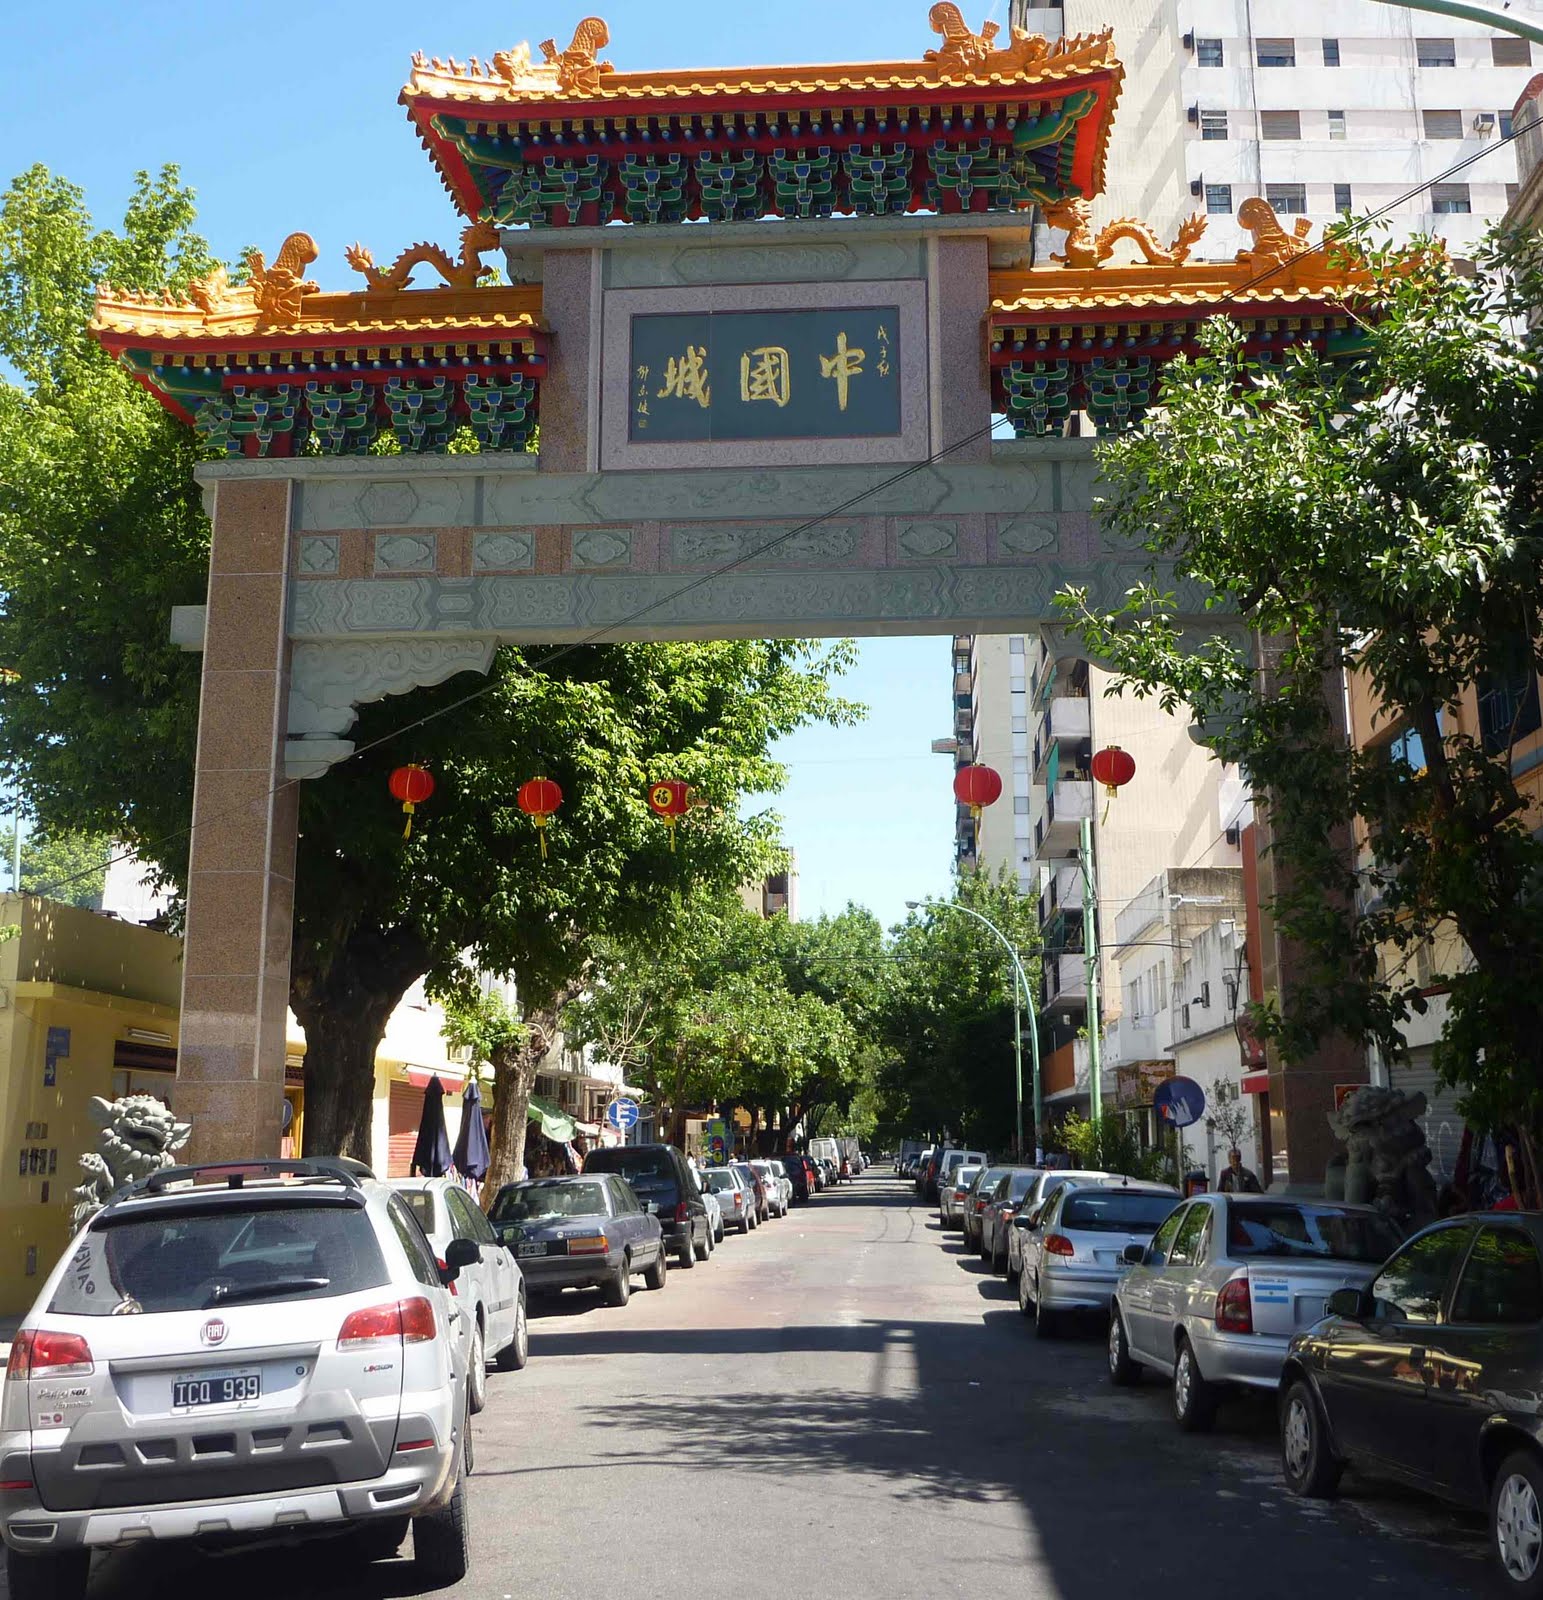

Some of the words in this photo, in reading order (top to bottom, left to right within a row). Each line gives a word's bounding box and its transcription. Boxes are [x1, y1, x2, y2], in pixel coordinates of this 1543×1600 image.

[657, 331, 866, 411] 中國城
[654, 788, 668, 804] 福
[616, 1103, 630, 1123] E
[207, 1324, 224, 1338] FIAT
[176, 1381, 211, 1406] ICQ
[223, 1376, 258, 1401] 939
